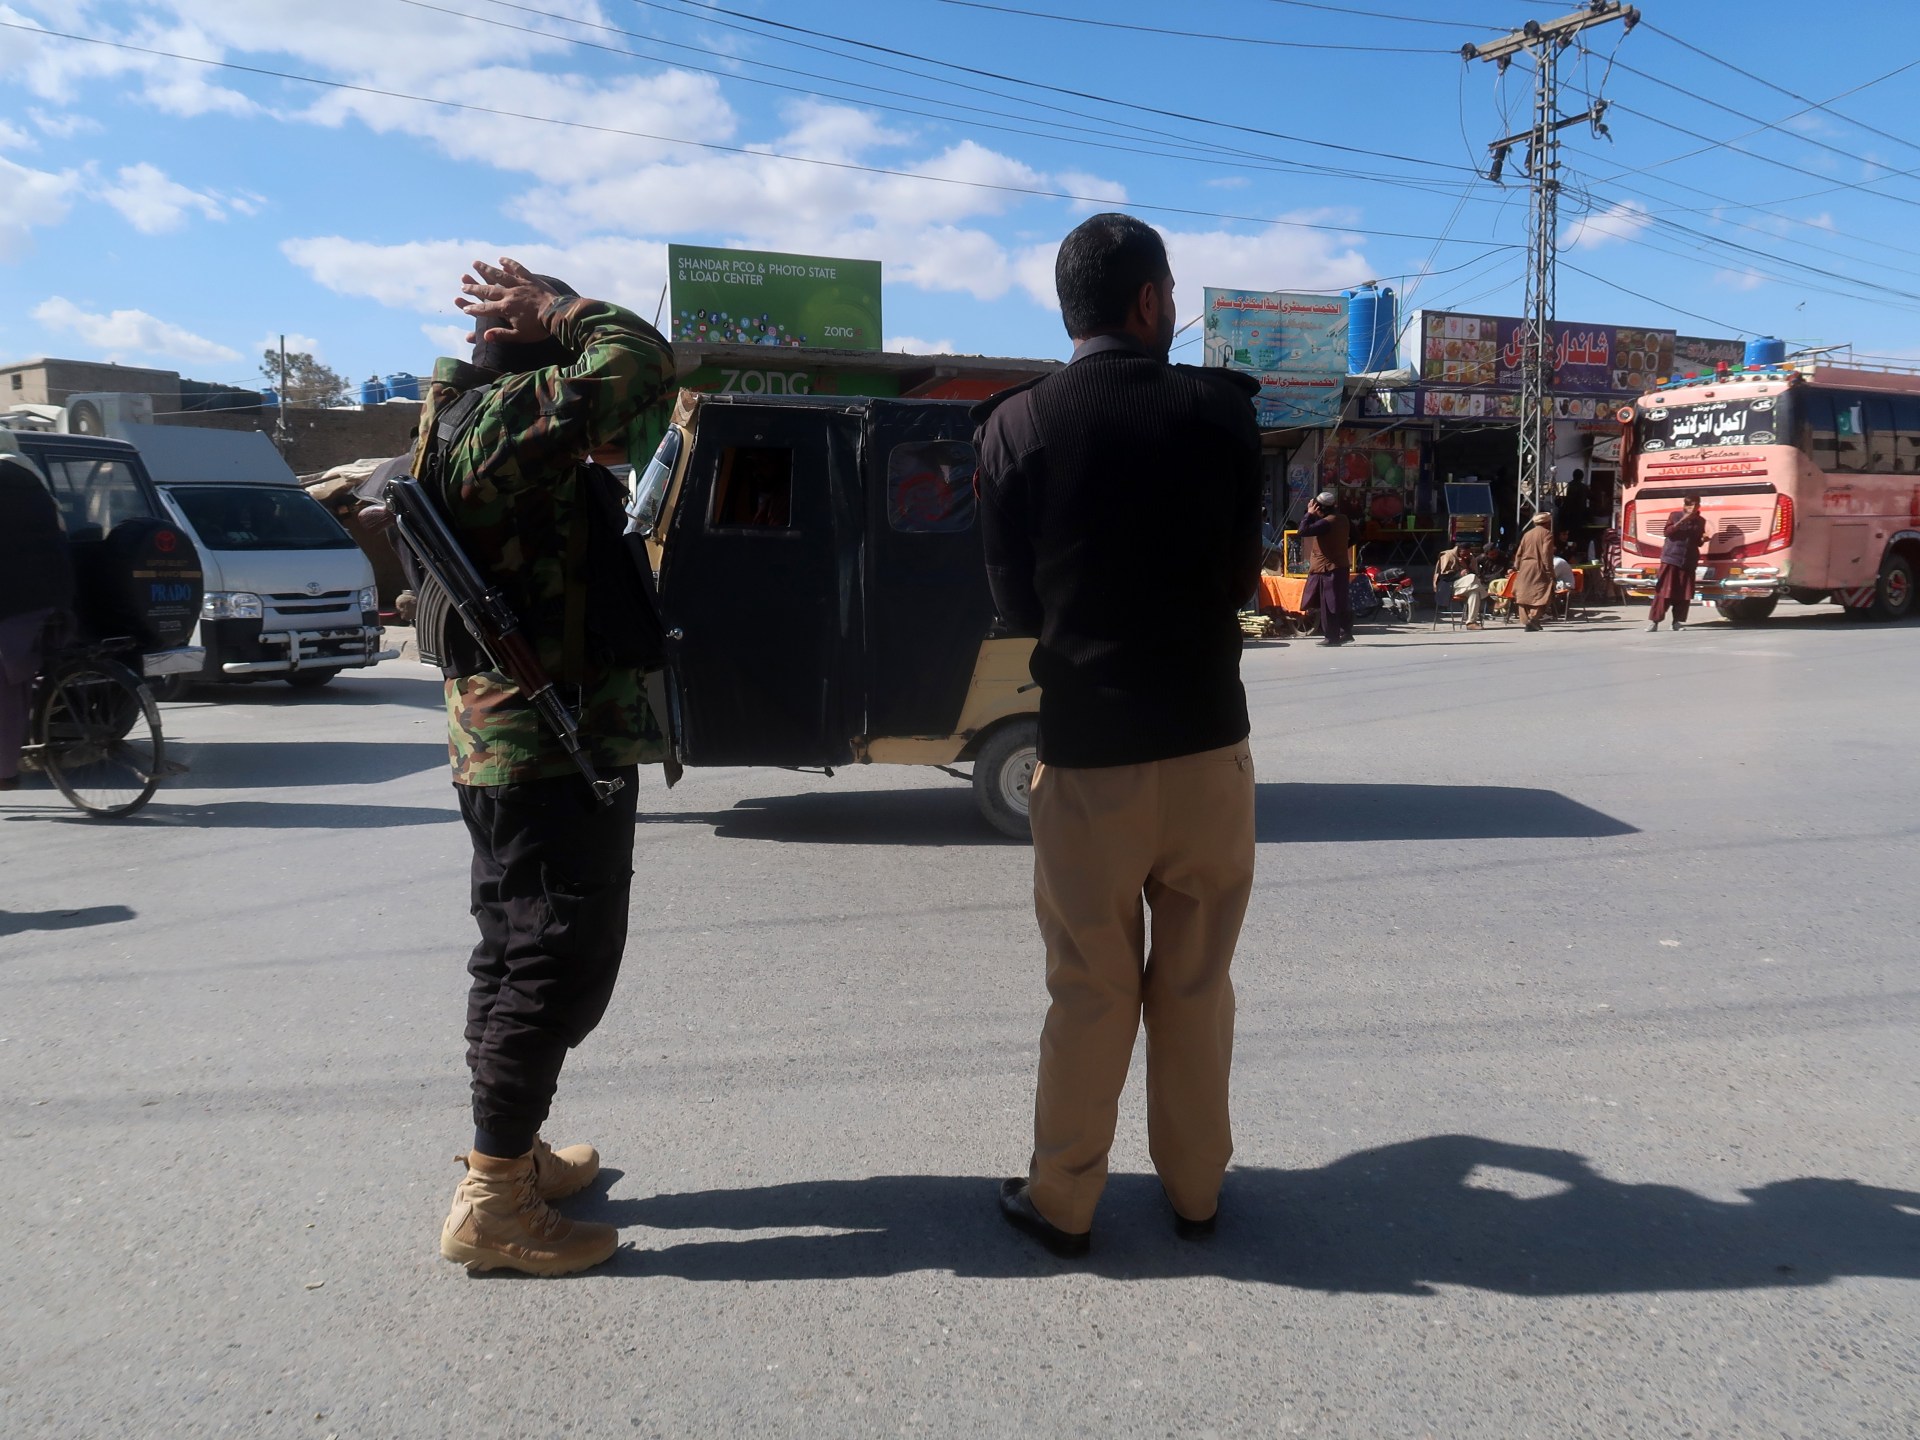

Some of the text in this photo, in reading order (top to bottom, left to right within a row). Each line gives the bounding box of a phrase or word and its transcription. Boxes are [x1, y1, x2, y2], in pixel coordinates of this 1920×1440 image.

[678, 257, 836, 279] SHANDAR PCO & PHOTO STATE
[678, 270, 763, 286] & LOAD CENTER
[1553, 330, 1609, 372] شاندار
[1713, 410, 1748, 437] اکمل
[1720, 434, 1745, 445] 2021
[1669, 452, 1701, 461] Royal
[1703, 450, 1740, 459] Saloon
[1658, 463, 1752, 475] JAWED KHAN
[151, 583, 191, 602] PRADO
